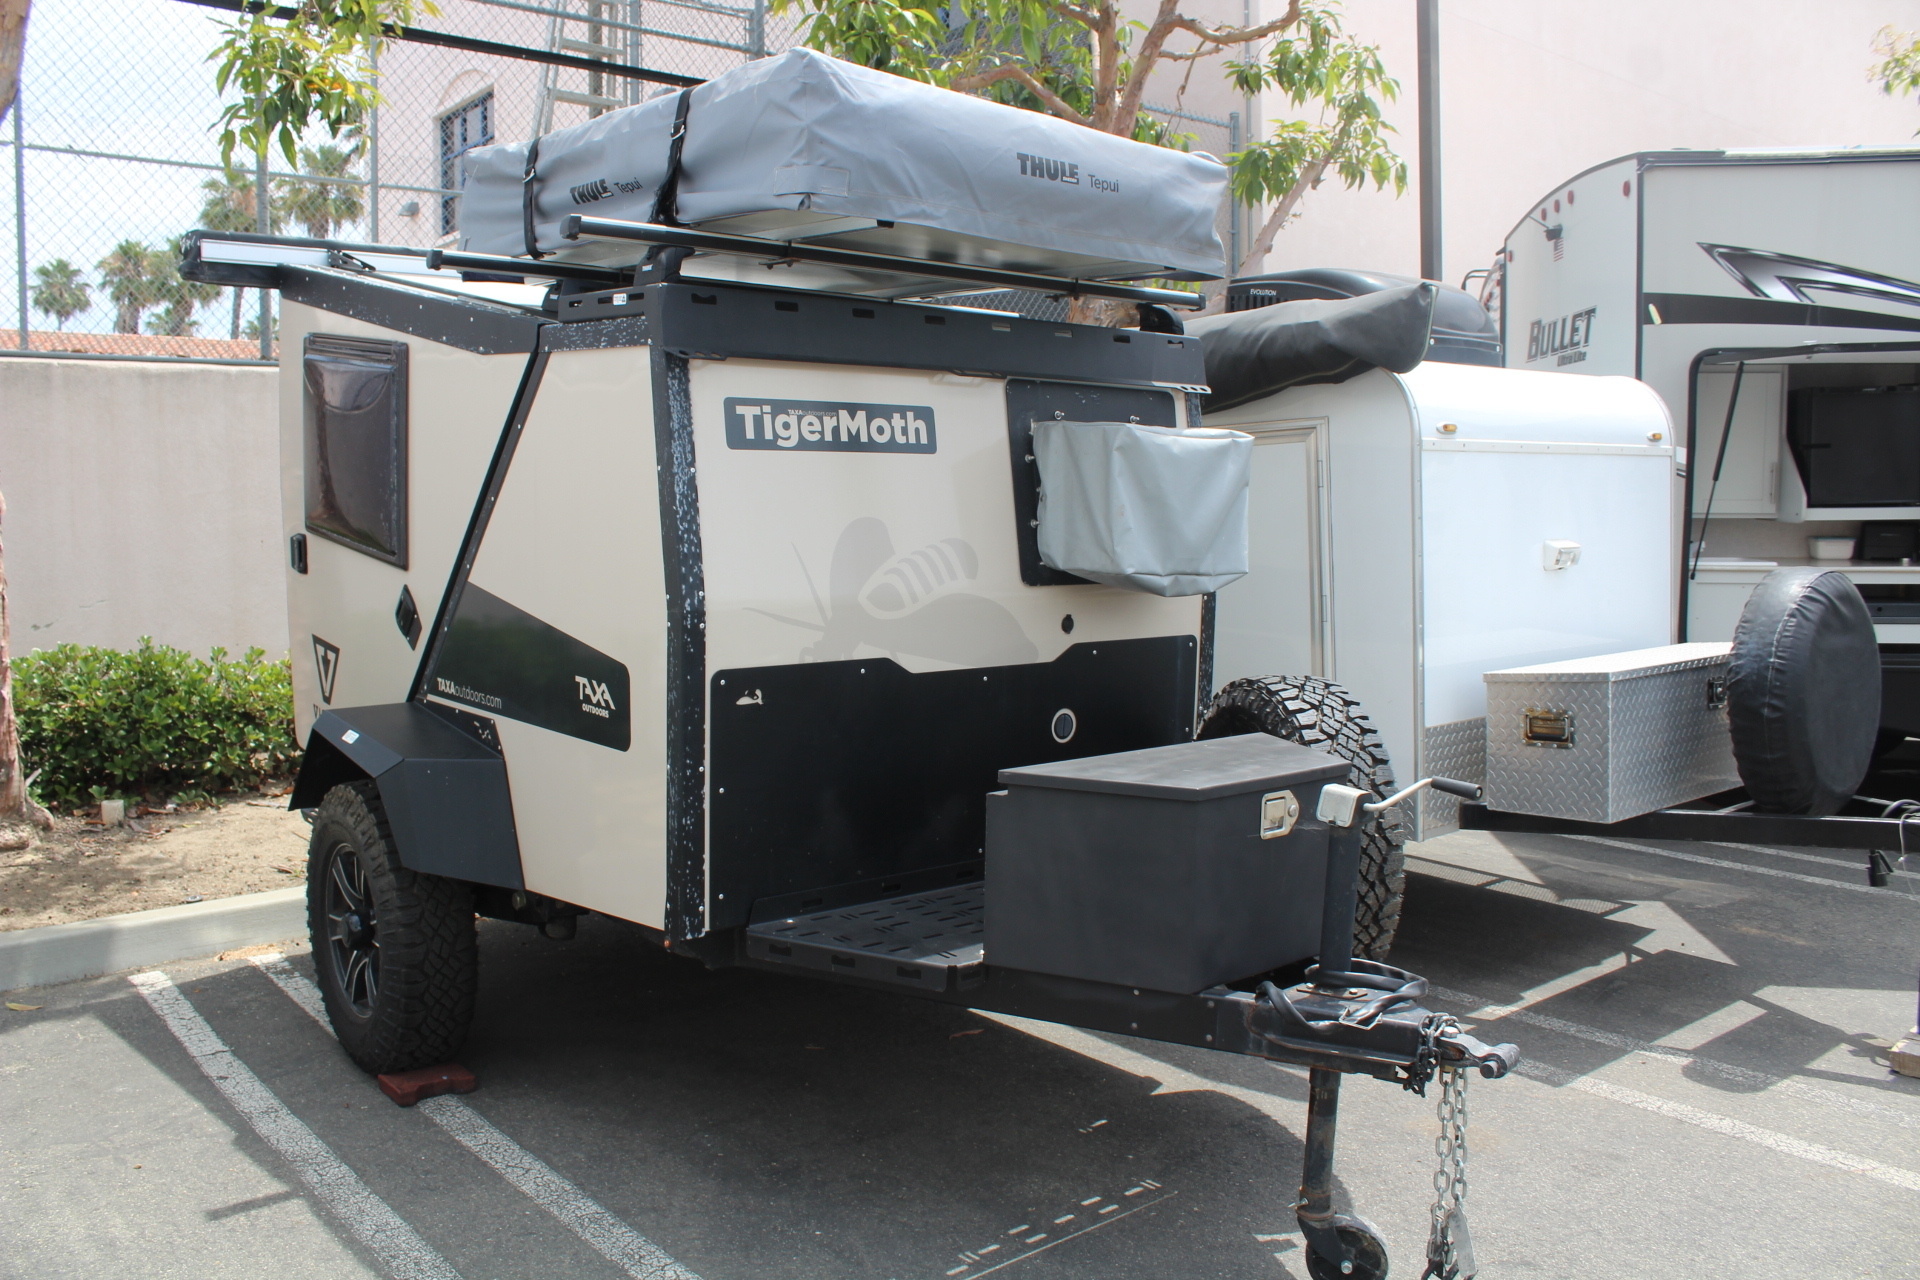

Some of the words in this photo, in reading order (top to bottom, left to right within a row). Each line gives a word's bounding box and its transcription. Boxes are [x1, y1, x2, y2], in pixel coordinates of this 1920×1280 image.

[1017, 152, 1079, 185] THULE
[1088, 174, 1119, 193] Tepui
[570, 178, 614, 205] THULE
[614, 177, 643, 194] Tepui
[1250, 288, 1277, 296] EVOLUTION
[1525, 305, 1597, 363] BULLET
[735, 405, 928, 447] TigerMoth
[437, 677, 502, 709] TAXAoutdoors.com
[582, 703, 609, 718] OUTDOORS
